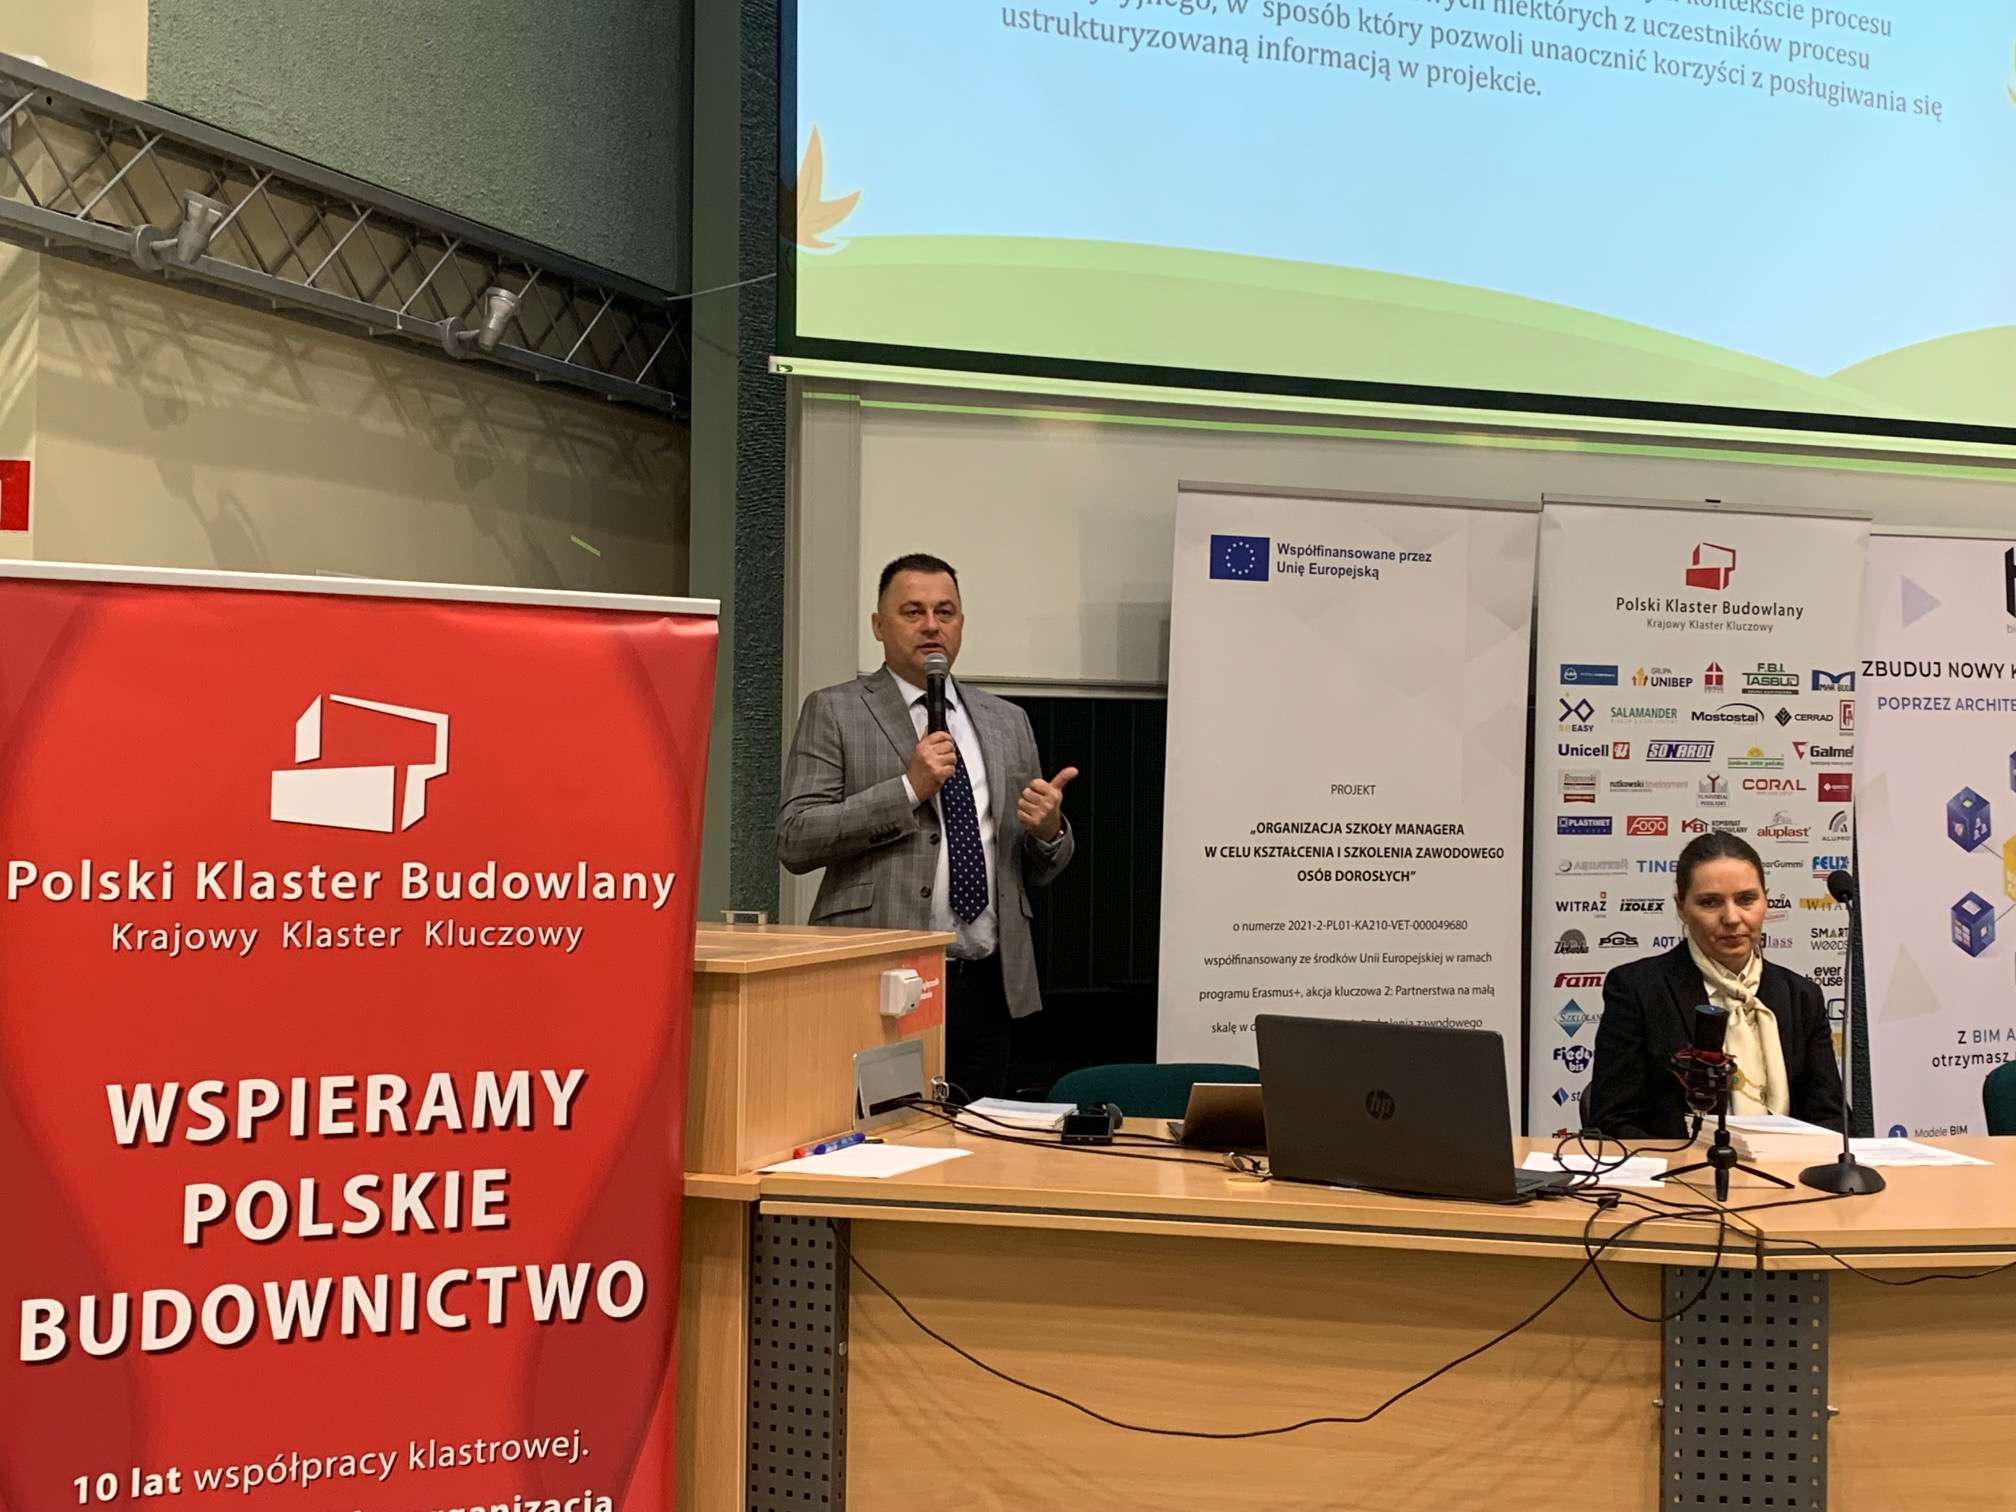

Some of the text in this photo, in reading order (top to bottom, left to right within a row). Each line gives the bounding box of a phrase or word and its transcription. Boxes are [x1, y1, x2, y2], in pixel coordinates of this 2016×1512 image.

[1811, 6, 1892, 37] procesu
[1624, 15, 1636, 33] z
[1643, 17, 1782, 53] uczestników
[1789, 39, 1870, 70] procesu
[1001, 7, 1541, 96] ustrukturyzowaną informacją w projekcie.
[1262, 0, 1350, 29] sposób
[1358, 8, 1424, 46] który
[1430, 25, 1523, 56] pozwoli
[1531, 38, 1647, 72] unaocznić
[1654, 51, 1745, 87] korzyści
[1752, 71, 1763, 89] z
[1770, 73, 1907, 114] posługiwania
[1913, 95, 1943, 122] się
[1277, 542, 1432, 563] Współfinansowane przez
[1277, 562, 1379, 580] Unię Europejską
[1616, 597, 1804, 619] Polski Klaster Budowlany
[1647, 618, 1773, 633] Krajowy Klaster Kluczowy
[1861, 661, 1941, 677] ZBUDUJ
[1949, 663, 2005, 679] NOWY
[1651, 677, 1693, 688] UNIBEP
[1743, 673, 1799, 687] TASBUD
[1878, 697, 1951, 711] POPRZEZ
[1611, 707, 1677, 719] SALAMANDER
[1691, 711, 1759, 722] Mostostal
[1795, 713, 1833, 722] CERRAD
[1558, 744, 1608, 757] Unicell
[1331, 784, 1376, 795] PROJEKT
[1743, 778, 1807, 790] CORAL
[1250, 821, 1464, 835] „ORGANIZACJA SZKOŁY MANAGERA
[1757, 825, 1809, 839] aluplast
[1205, 846, 1504, 859] W CELU KSZTAŁCENIA I SZKOLENIA ZAWODOWEGO
[1812, 856, 1848, 870] FELIX
[1297, 868, 1332, 882] OSÓB
[7, 859, 676, 910] Polski Klaster Budowlany
[1233, 919, 1467, 931] o numerze 2021-2-PL01-KA210-VET-000049680
[112, 920, 583, 957] Krajowy Klaster Kluczowy
[1204, 952, 1492, 967] współfinansowany ze środków Unii Europejskiej w ramach
[1814, 966, 1842, 977] ever
[1199, 984, 1494, 1001] programu Erasmus+, akcja kluczowa 2: Partnerstwa na małą
[1211, 1021, 1237, 1034] skalę
[1240, 1024, 1248, 1032] w
[1957, 1031, 1967, 1044] Z
[1973, 1030, 2000, 1043] BIM
[1932, 1051, 2008, 1068] otrzymasz
[106, 1068, 588, 1146] WSPIERAMY
[1915, 1127, 1948, 1138] Modele
[1950, 1125, 1968, 1135] BIM
[183, 1168, 509, 1246] POLSKIE
[20, 1260, 647, 1363] BUDOWNICTWO
[73, 1429, 590, 1504] 10 lat współpracy klastrowej.
